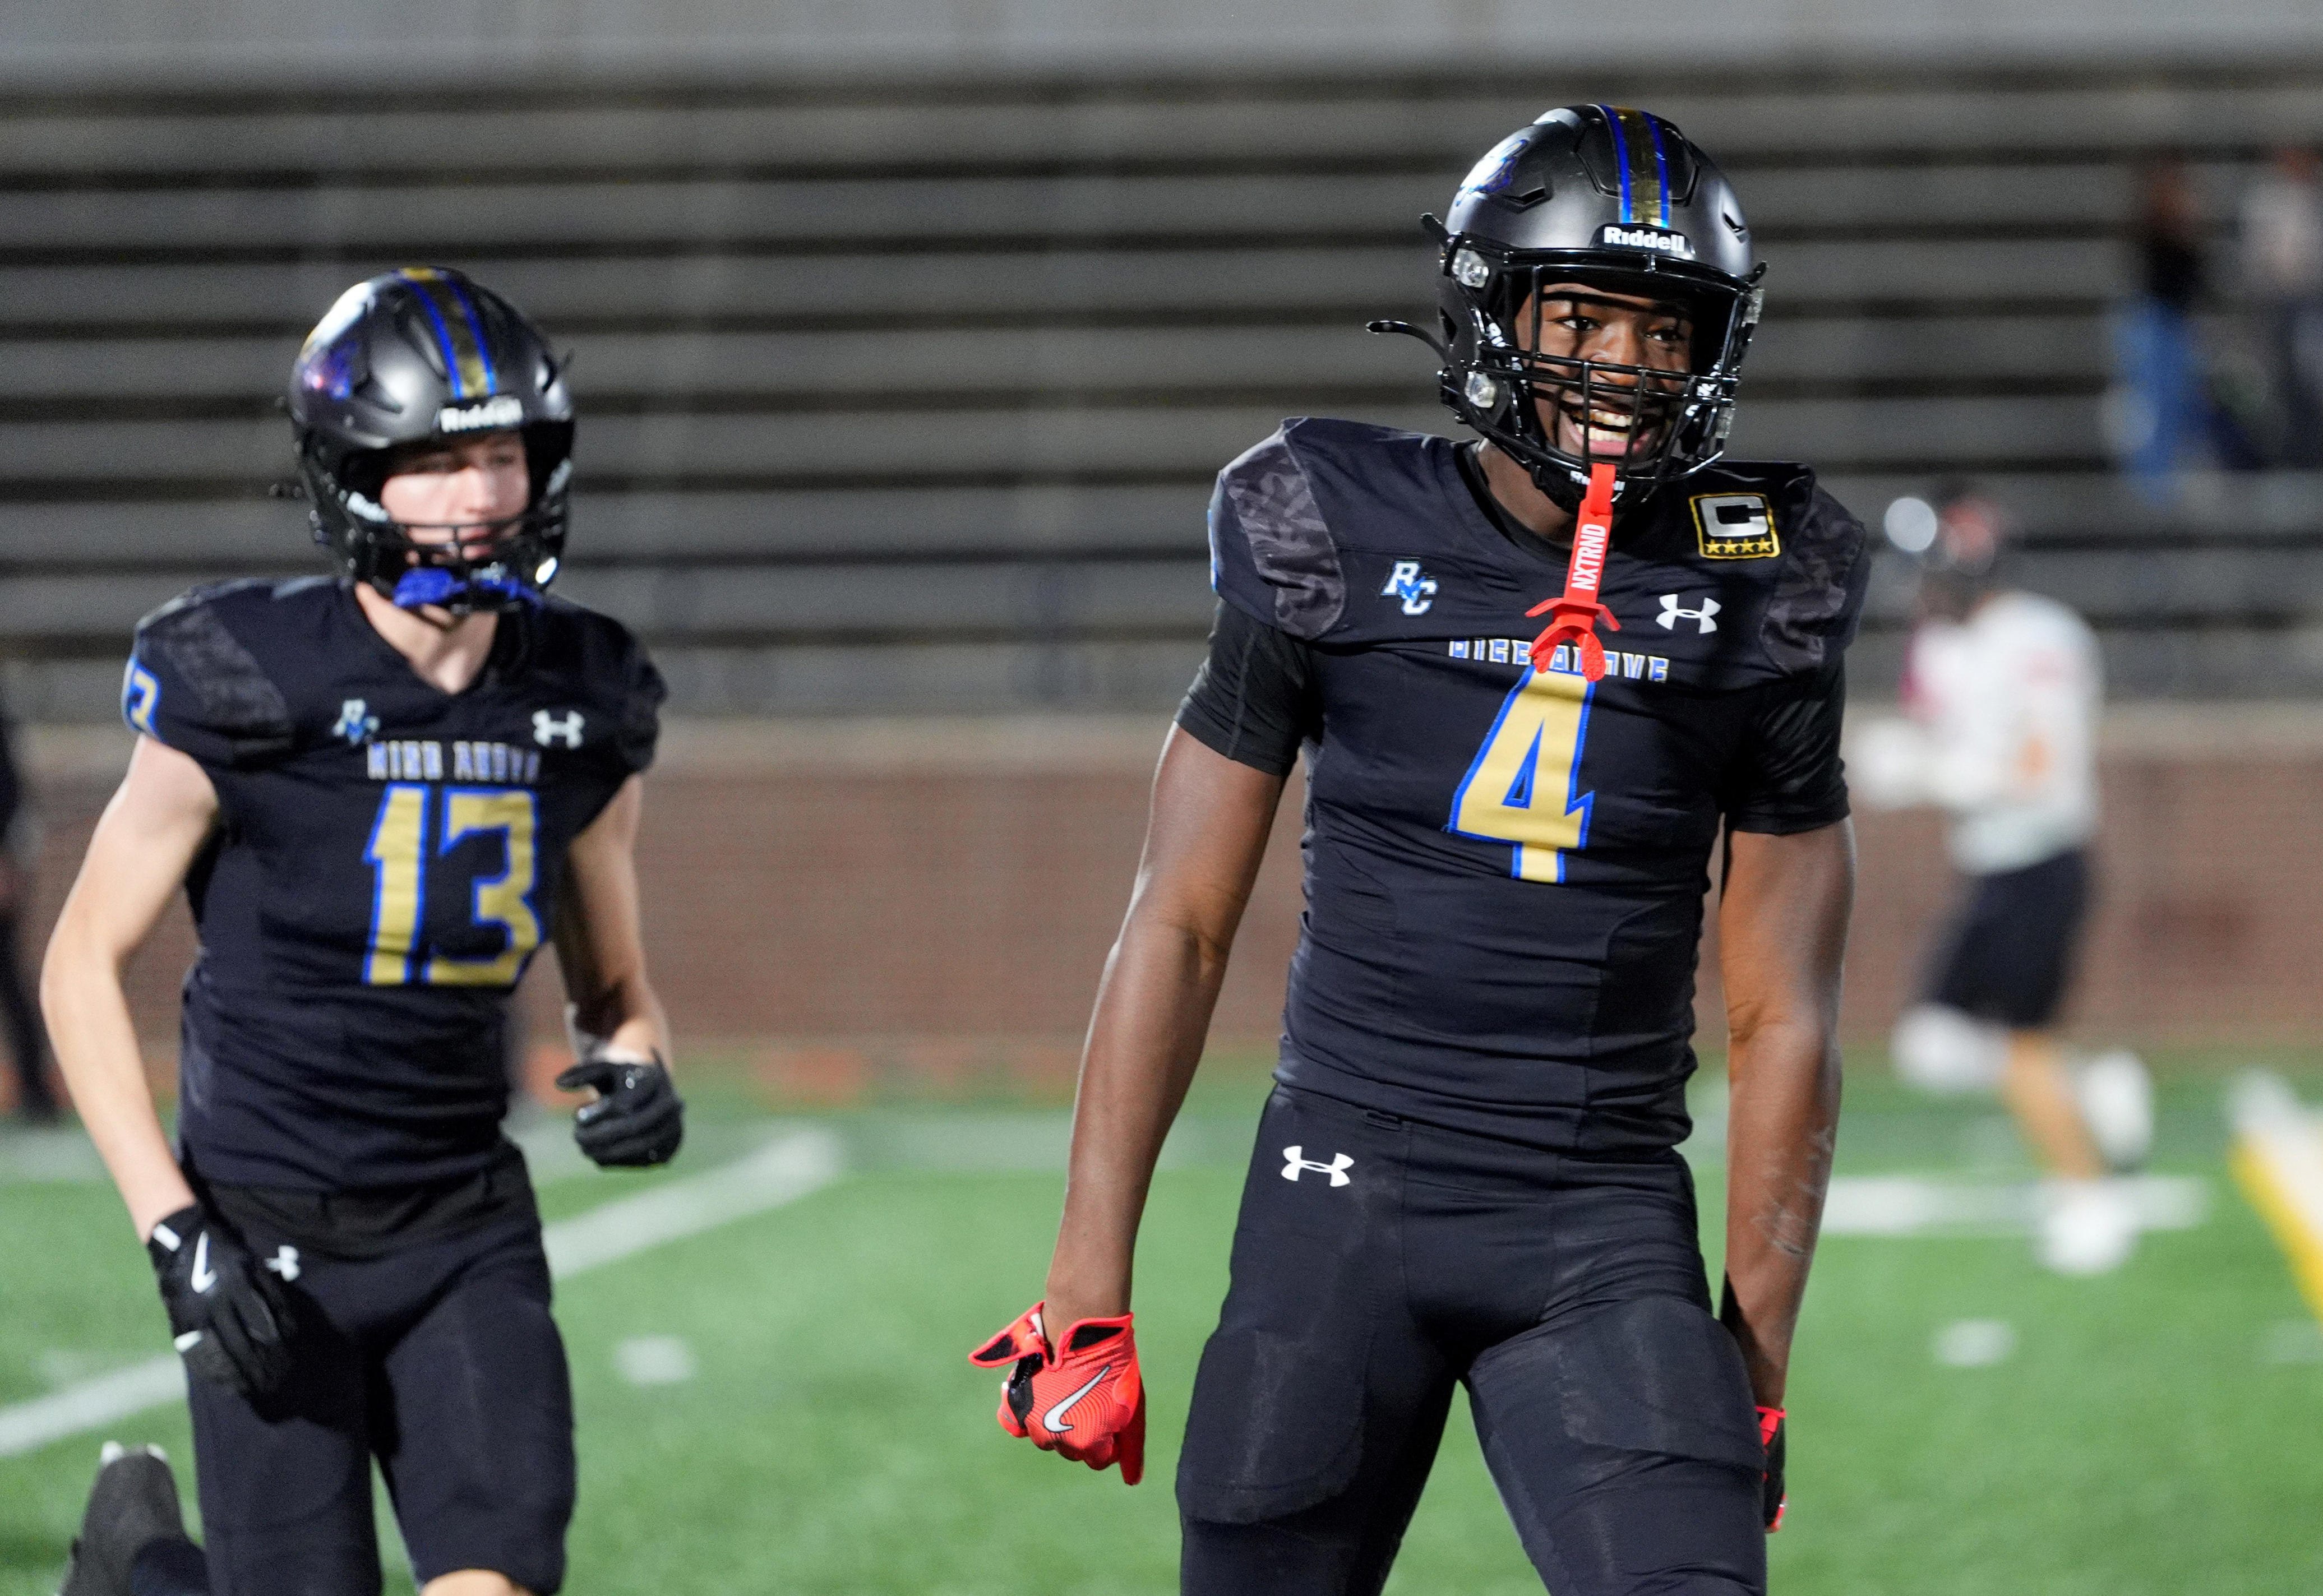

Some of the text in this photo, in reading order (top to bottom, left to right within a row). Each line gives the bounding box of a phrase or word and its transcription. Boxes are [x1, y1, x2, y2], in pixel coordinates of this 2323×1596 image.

[1604, 226, 1685, 252] Riddell
[1700, 496, 1768, 536] C
[1571, 524, 1606, 590] NXTRND
[1448, 665, 1596, 883] 4
[362, 781, 545, 986] 13
